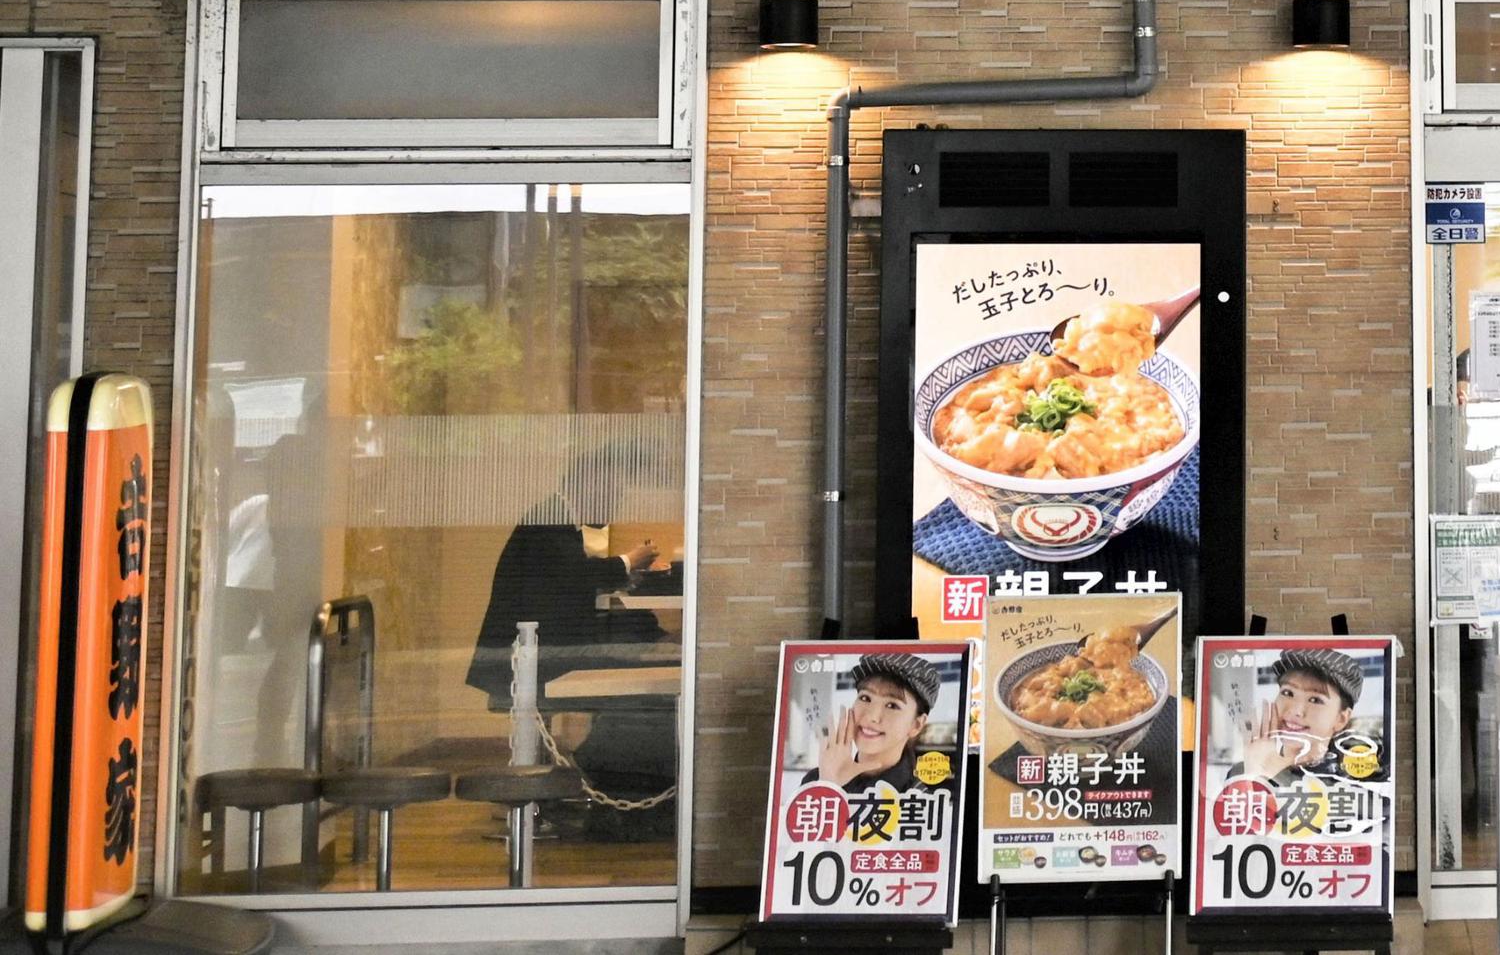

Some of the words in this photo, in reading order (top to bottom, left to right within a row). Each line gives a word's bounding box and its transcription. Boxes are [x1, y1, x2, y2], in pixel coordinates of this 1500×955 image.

[1427, 188, 1482, 200] 防犯カメラ設置
[952, 259, 1062, 304] だしたっぷり、
[947, 580, 983, 617] 新
[1020, 756, 1042, 780] 新
[1047, 751, 1146, 786] 親子丼
[1059, 832, 1092, 841] どれでも
[855, 852, 923, 871] 定食全品
[1286, 845, 1355, 863] 定食全品
